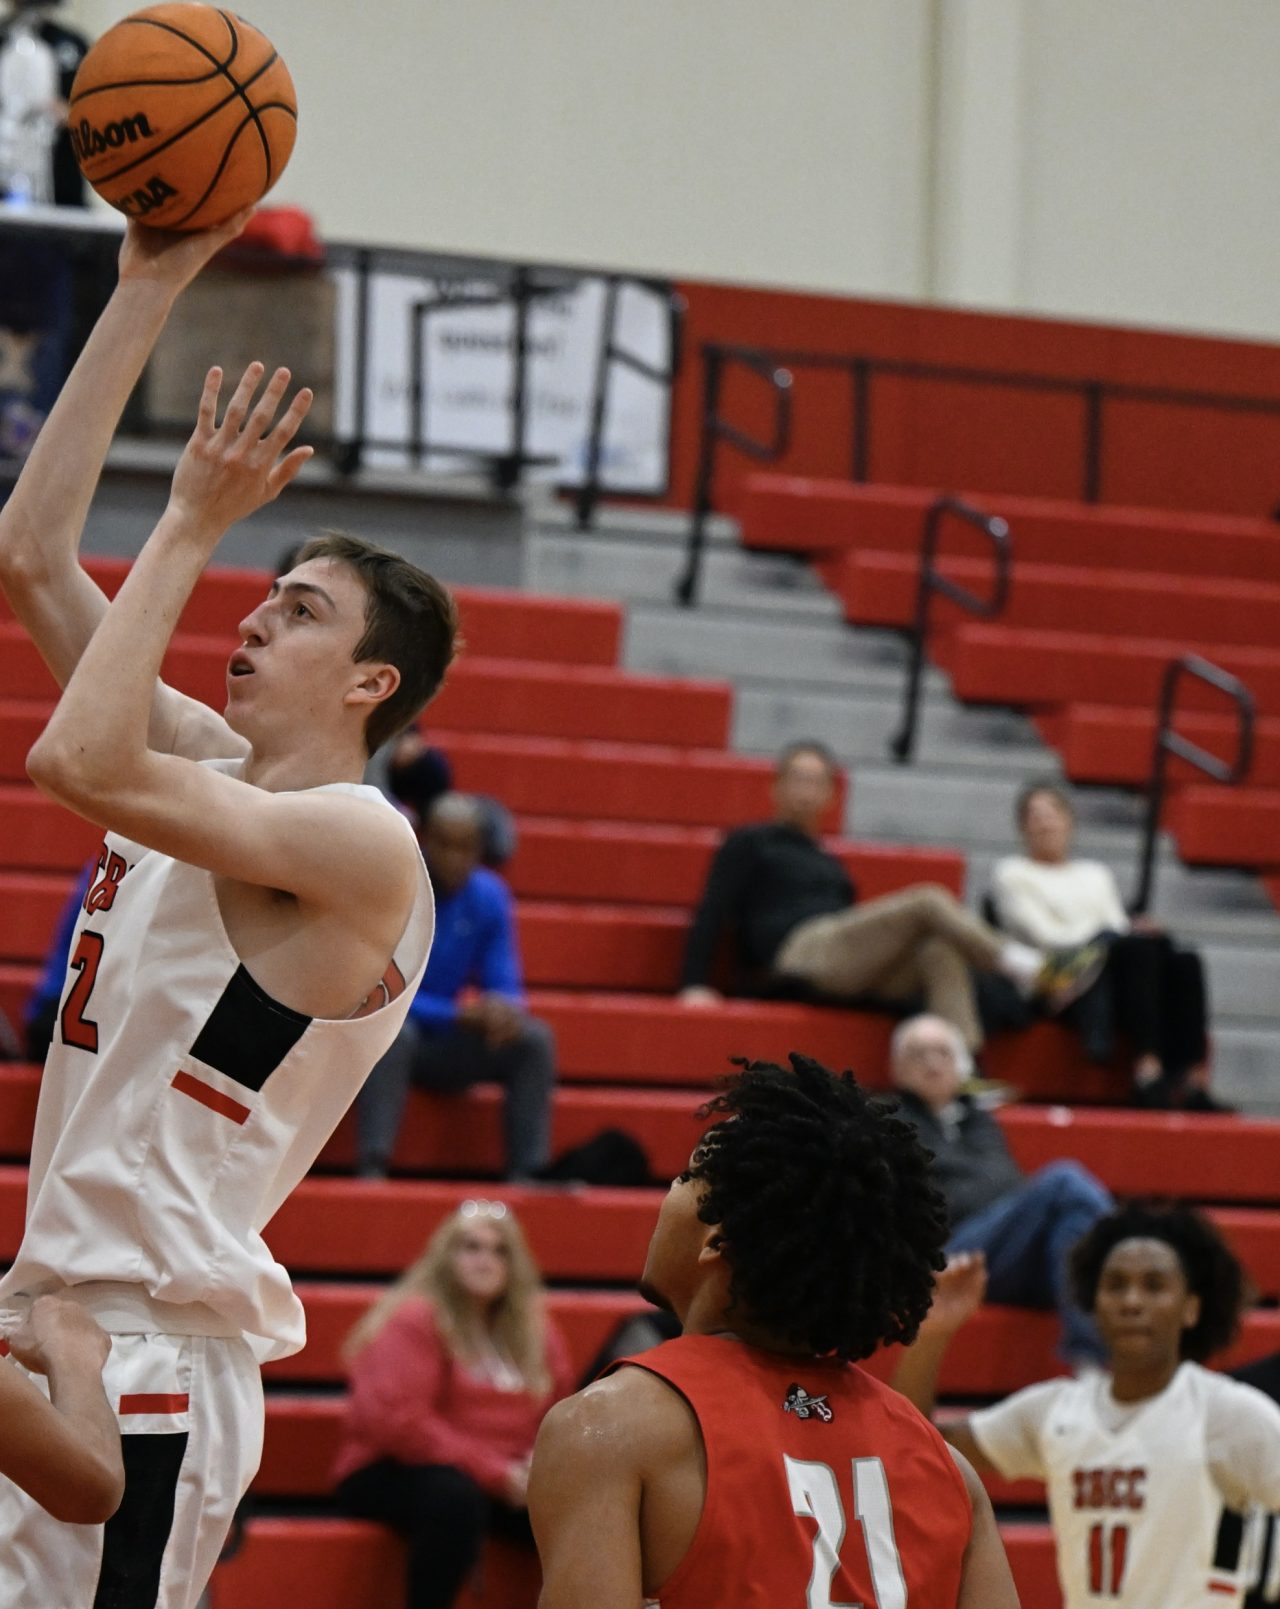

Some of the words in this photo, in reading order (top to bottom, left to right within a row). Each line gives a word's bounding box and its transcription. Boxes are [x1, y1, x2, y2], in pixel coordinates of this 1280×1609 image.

[114, 175, 179, 216] CAA
[783, 1452, 908, 1609] 21
[1087, 1521, 1129, 1597] 11
